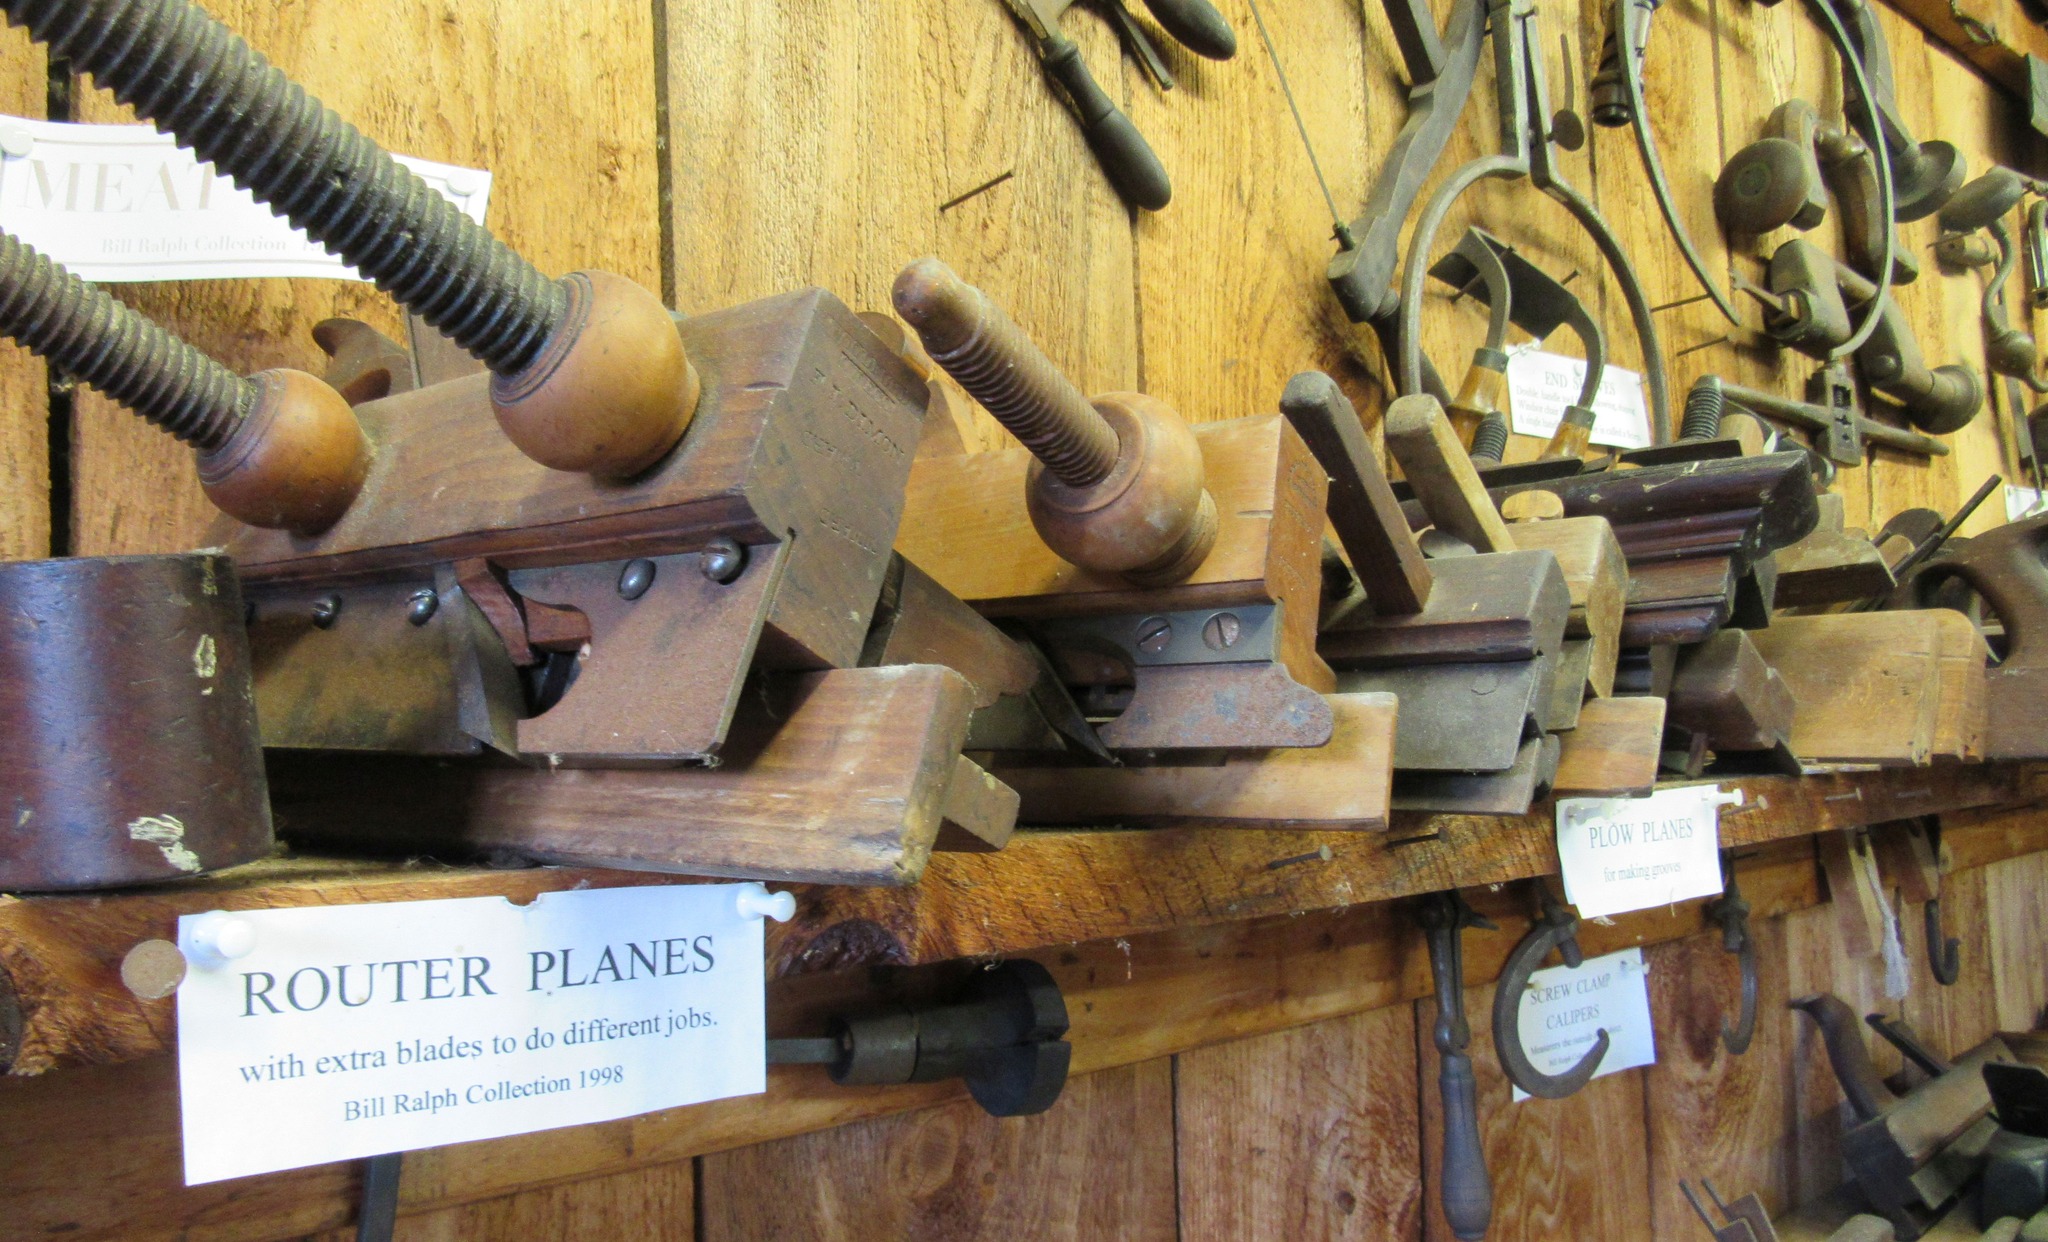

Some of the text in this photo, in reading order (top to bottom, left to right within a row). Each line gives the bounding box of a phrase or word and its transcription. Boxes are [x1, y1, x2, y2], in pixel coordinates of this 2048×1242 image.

[102, 238, 132, 254] Bill
[138, 236, 188, 257] Ralph
[194, 235, 287, 252] Collection
[1545, 371, 1568, 389] END
[1589, 817, 1694, 849] PLOW PLANES
[1603, 861, 1682, 883] for making grooves
[239, 934, 715, 1018] ROUTER PLANES
[1530, 972, 1611, 1006] SCREW CLAMP
[1546, 1004, 1601, 1030] CALIPERS
[240, 1004, 718, 1085] with extra blades to do different jobs.
[343, 1064, 625, 1122] Bill Ralph Collection 1998
